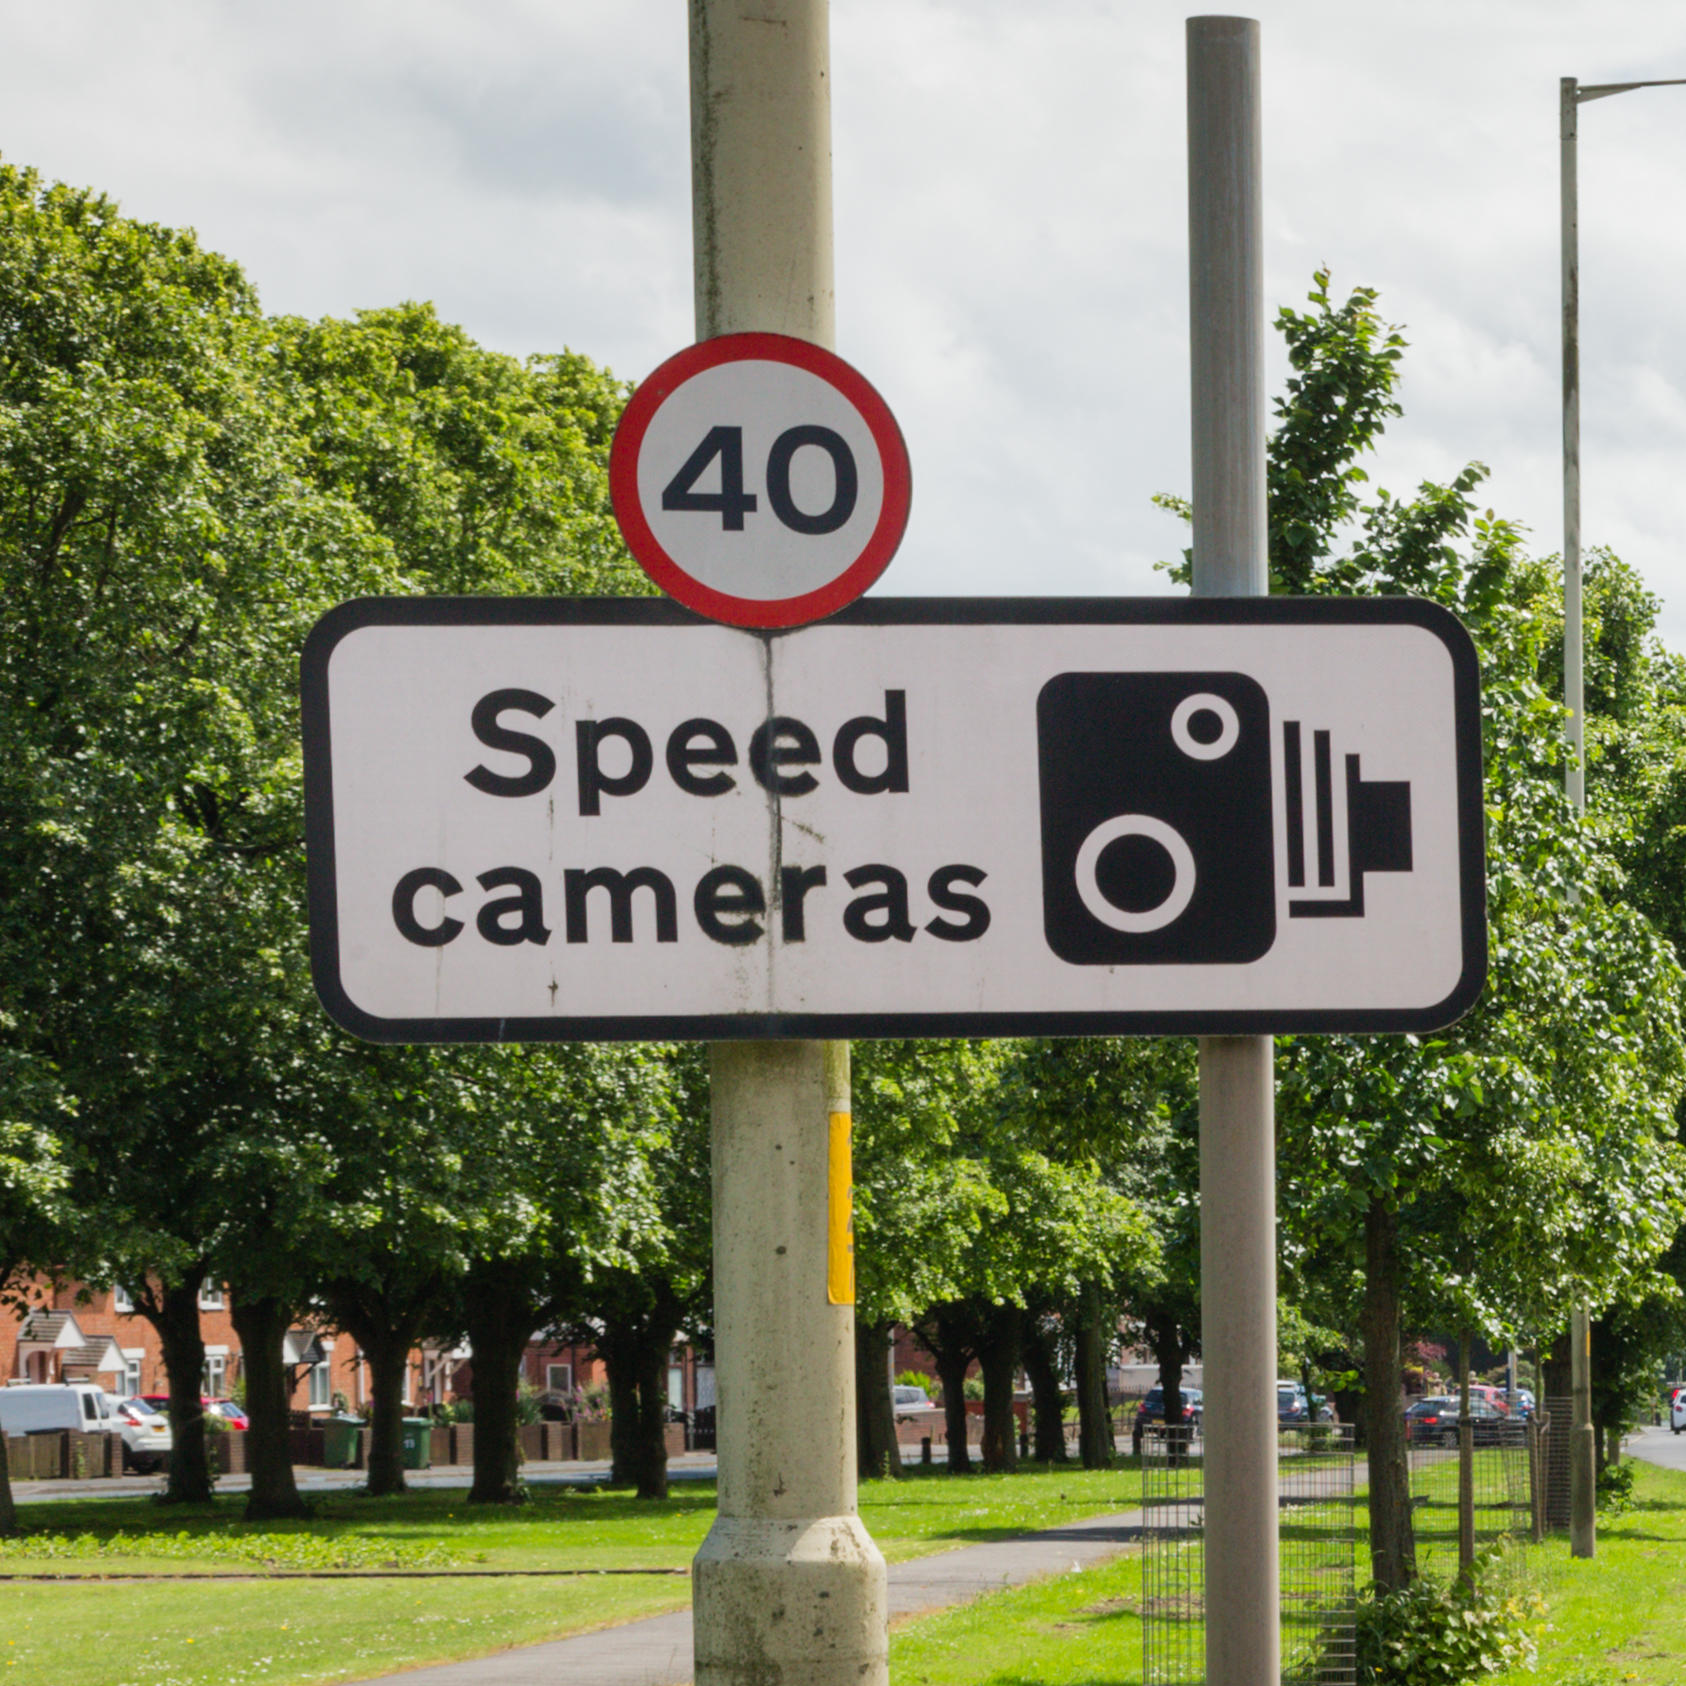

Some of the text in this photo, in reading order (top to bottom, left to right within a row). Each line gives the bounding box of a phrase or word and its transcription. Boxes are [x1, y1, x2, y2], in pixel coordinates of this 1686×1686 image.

[661, 423, 859, 536] 40
[463, 687, 911, 817] Speed
[391, 861, 992, 948] cameras
